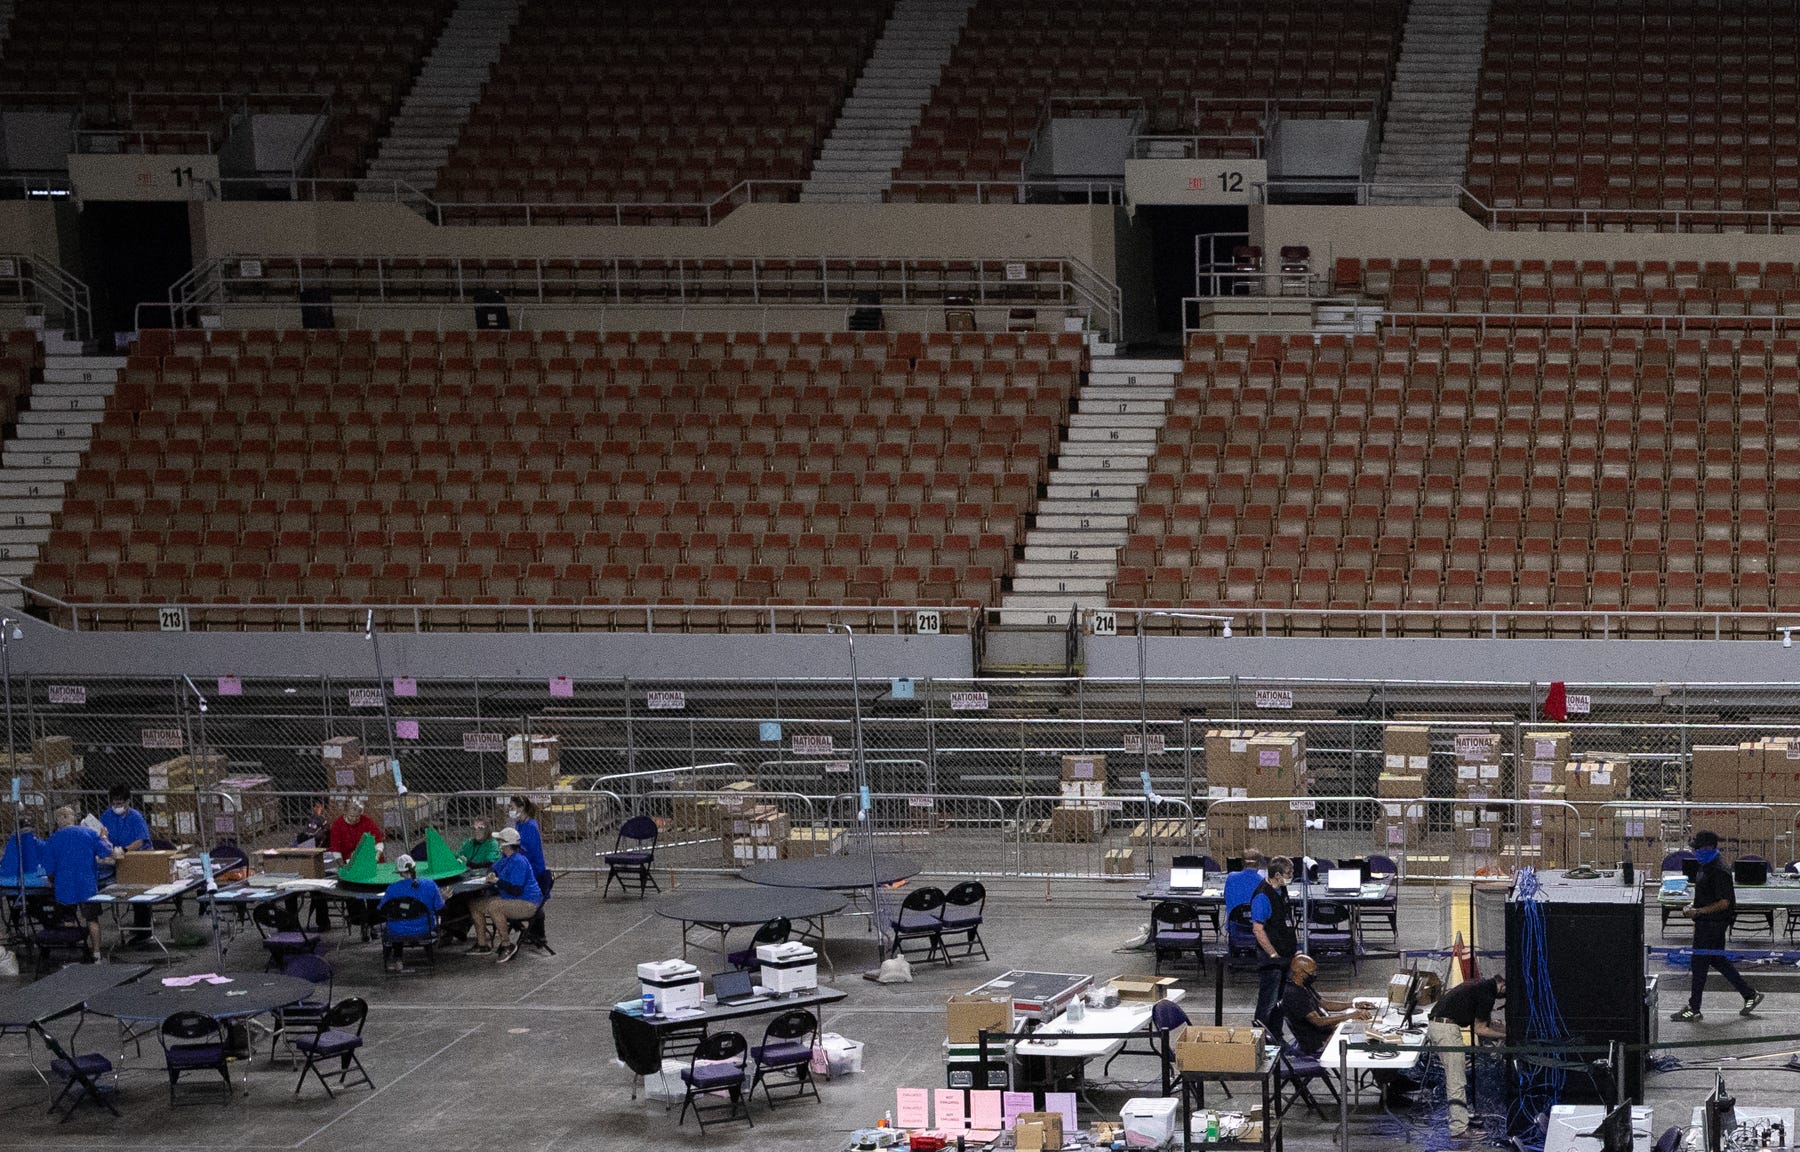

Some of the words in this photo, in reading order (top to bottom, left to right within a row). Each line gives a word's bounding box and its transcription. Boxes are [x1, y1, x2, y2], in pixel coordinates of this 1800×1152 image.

[172, 168, 192, 187] 11
[1218, 173, 1244, 192] 12
[83, 373, 92, 381] 18
[1128, 376, 1136, 384] 18
[71, 400, 78, 408] 17
[1119, 404, 1127, 412] 17
[56, 428, 65, 436] 16
[1110, 432, 1118, 440] 16
[43, 456, 51, 464] 15
[1102, 460, 1110, 468] 15
[29, 487, 38, 495] 14
[1090, 490, 1100, 498] 14
[15, 516, 24, 524] 13
[1080, 520, 1089, 528] 13
[1070, 551, 1079, 560] 12
[1059, 583, 1065, 591] 11
[162, 612, 180, 627] 213
[919, 615, 937, 630] 213
[1047, 616, 1057, 624] 10
[1096, 616, 1114, 631] 214
[50, 687, 84, 695] NATIONAL
[648, 692, 684, 700] NATIONAL
[952, 692, 986, 700] NATIONAL
[1257, 691, 1291, 700] NATIONAL
[1568, 695, 1588, 704] IONAL
[143, 730, 180, 739] NATIONAL
[464, 734, 501, 743] NATIONAL
[793, 736, 831, 745] NATIONAL
[1125, 735, 1163, 744] NATINAL
[1456, 738, 1493, 747] NATIONAL
